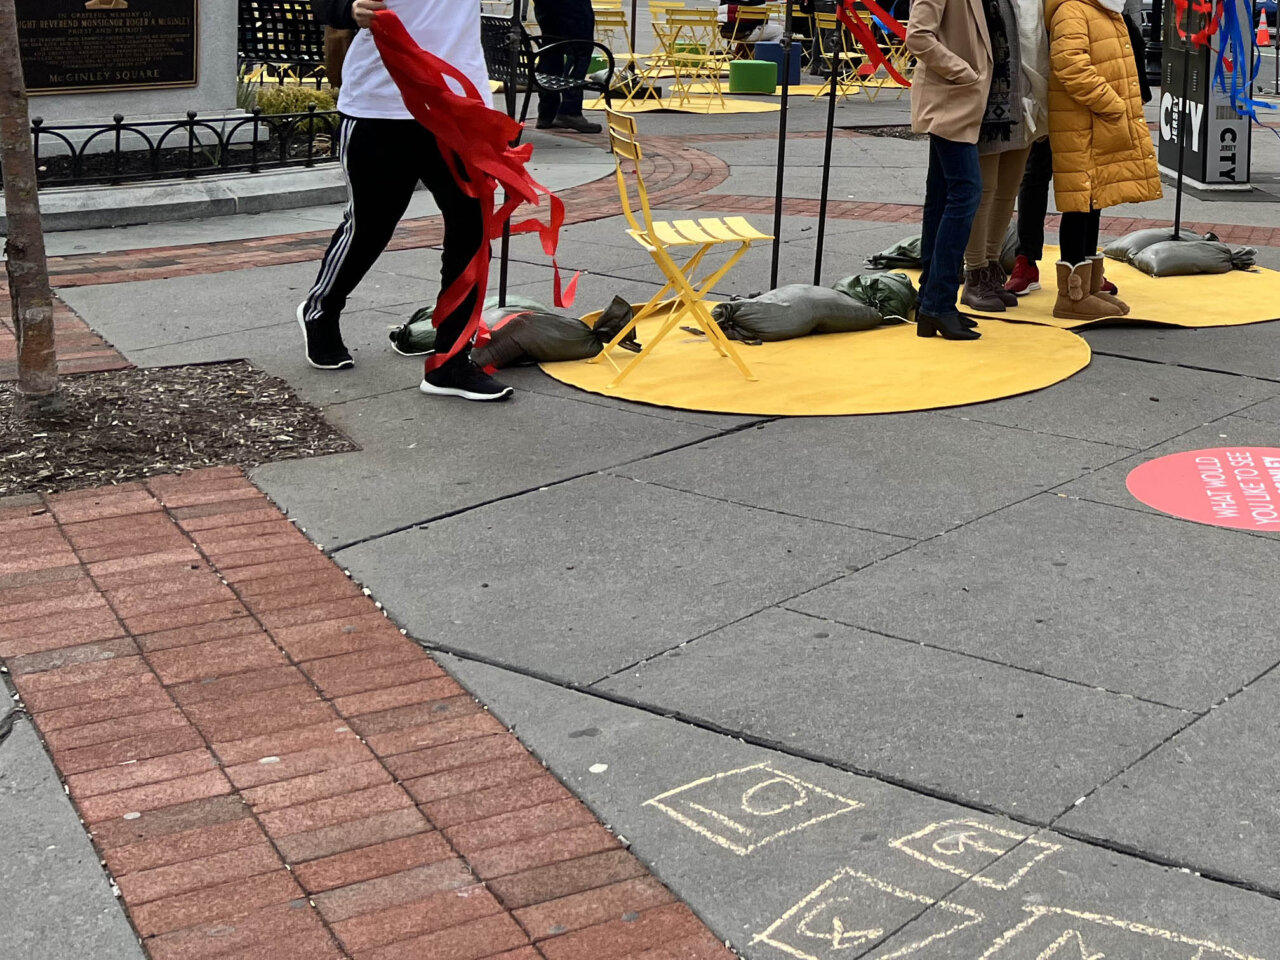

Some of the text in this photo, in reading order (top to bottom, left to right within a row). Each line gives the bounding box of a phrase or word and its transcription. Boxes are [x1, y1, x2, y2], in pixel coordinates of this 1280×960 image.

[50, 69, 160, 82] McGINLEY SQUARE
[1195, 456, 1241, 519] WHAT WOULD
[1226, 451, 1280, 525] YOU LIKE TO SEE
